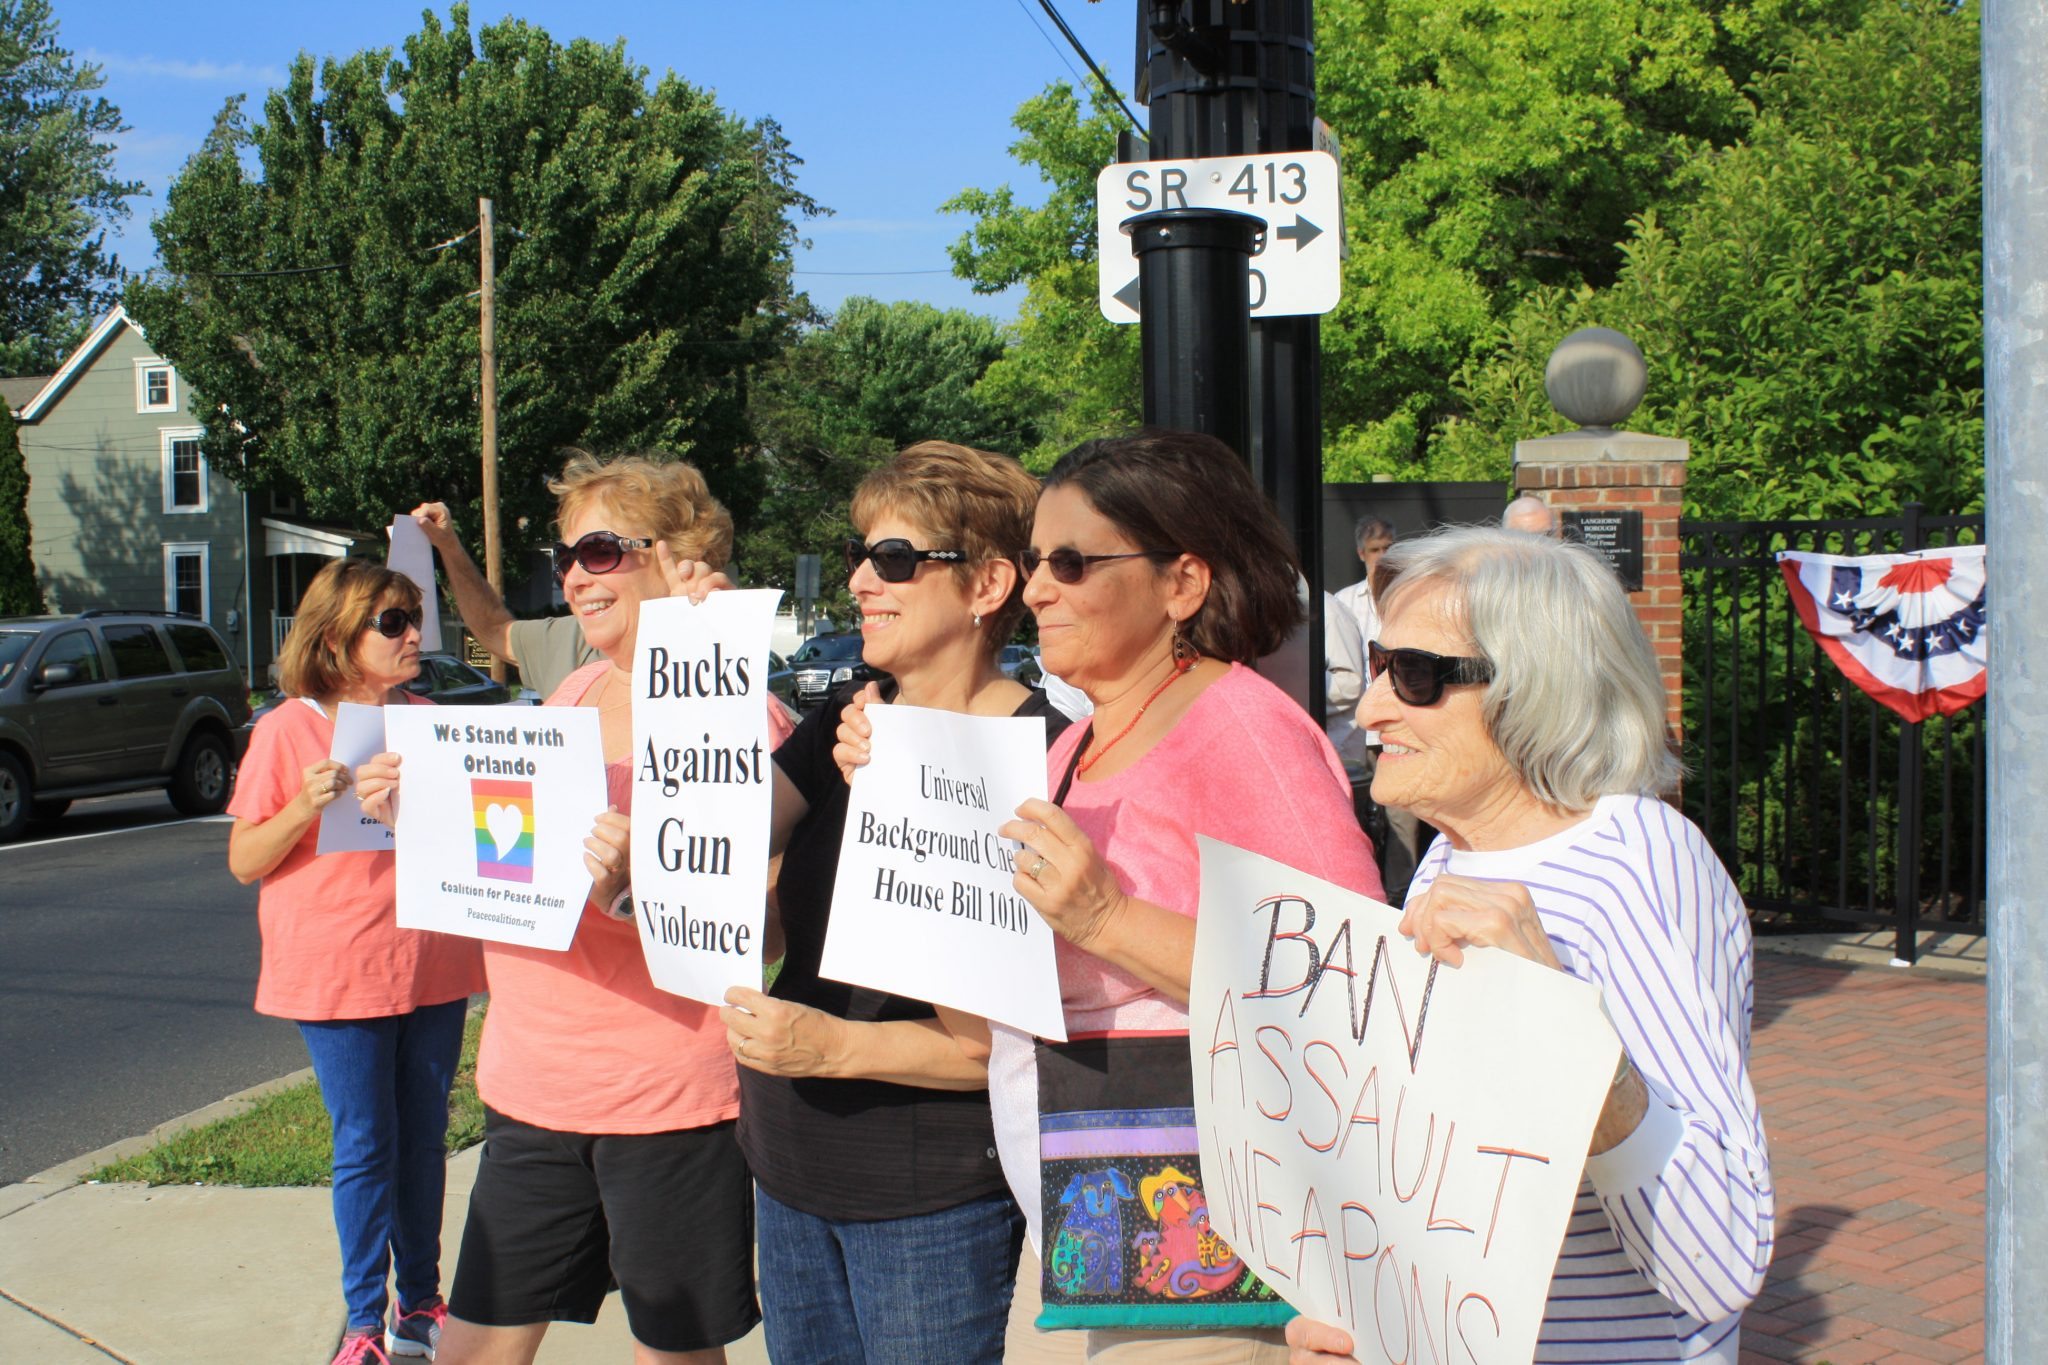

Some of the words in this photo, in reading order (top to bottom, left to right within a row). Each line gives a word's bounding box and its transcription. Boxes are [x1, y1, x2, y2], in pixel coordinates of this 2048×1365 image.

[1126, 168, 1189, 212] SR
[1228, 162, 1307, 205] 413
[647, 642, 750, 700] Bucks
[434, 723, 461, 743] We
[466, 724, 518, 745] Stand
[523, 727, 565, 747] with
[464, 754, 537, 776] Orlando
[638, 732, 764, 798] Against
[920, 764, 990, 812] Universal
[657, 817, 731, 876] Gun
[857, 811, 981, 863] Background
[985, 832, 1015, 875] Che
[441, 881, 484, 898] Coalition
[487, 887, 501, 899] for
[504, 889, 532, 904] Peace
[534, 894, 565, 909] Action
[467, 907, 537, 931] Peacecoalition.org
[873, 867, 944, 912] House
[950, 881, 983, 922] Bill
[989, 893, 1028, 936] 1010
[641, 900, 750, 956] Violence
[1242, 893, 1439, 1074] BAN
[1209, 989, 1549, 1259] ASSAULT
